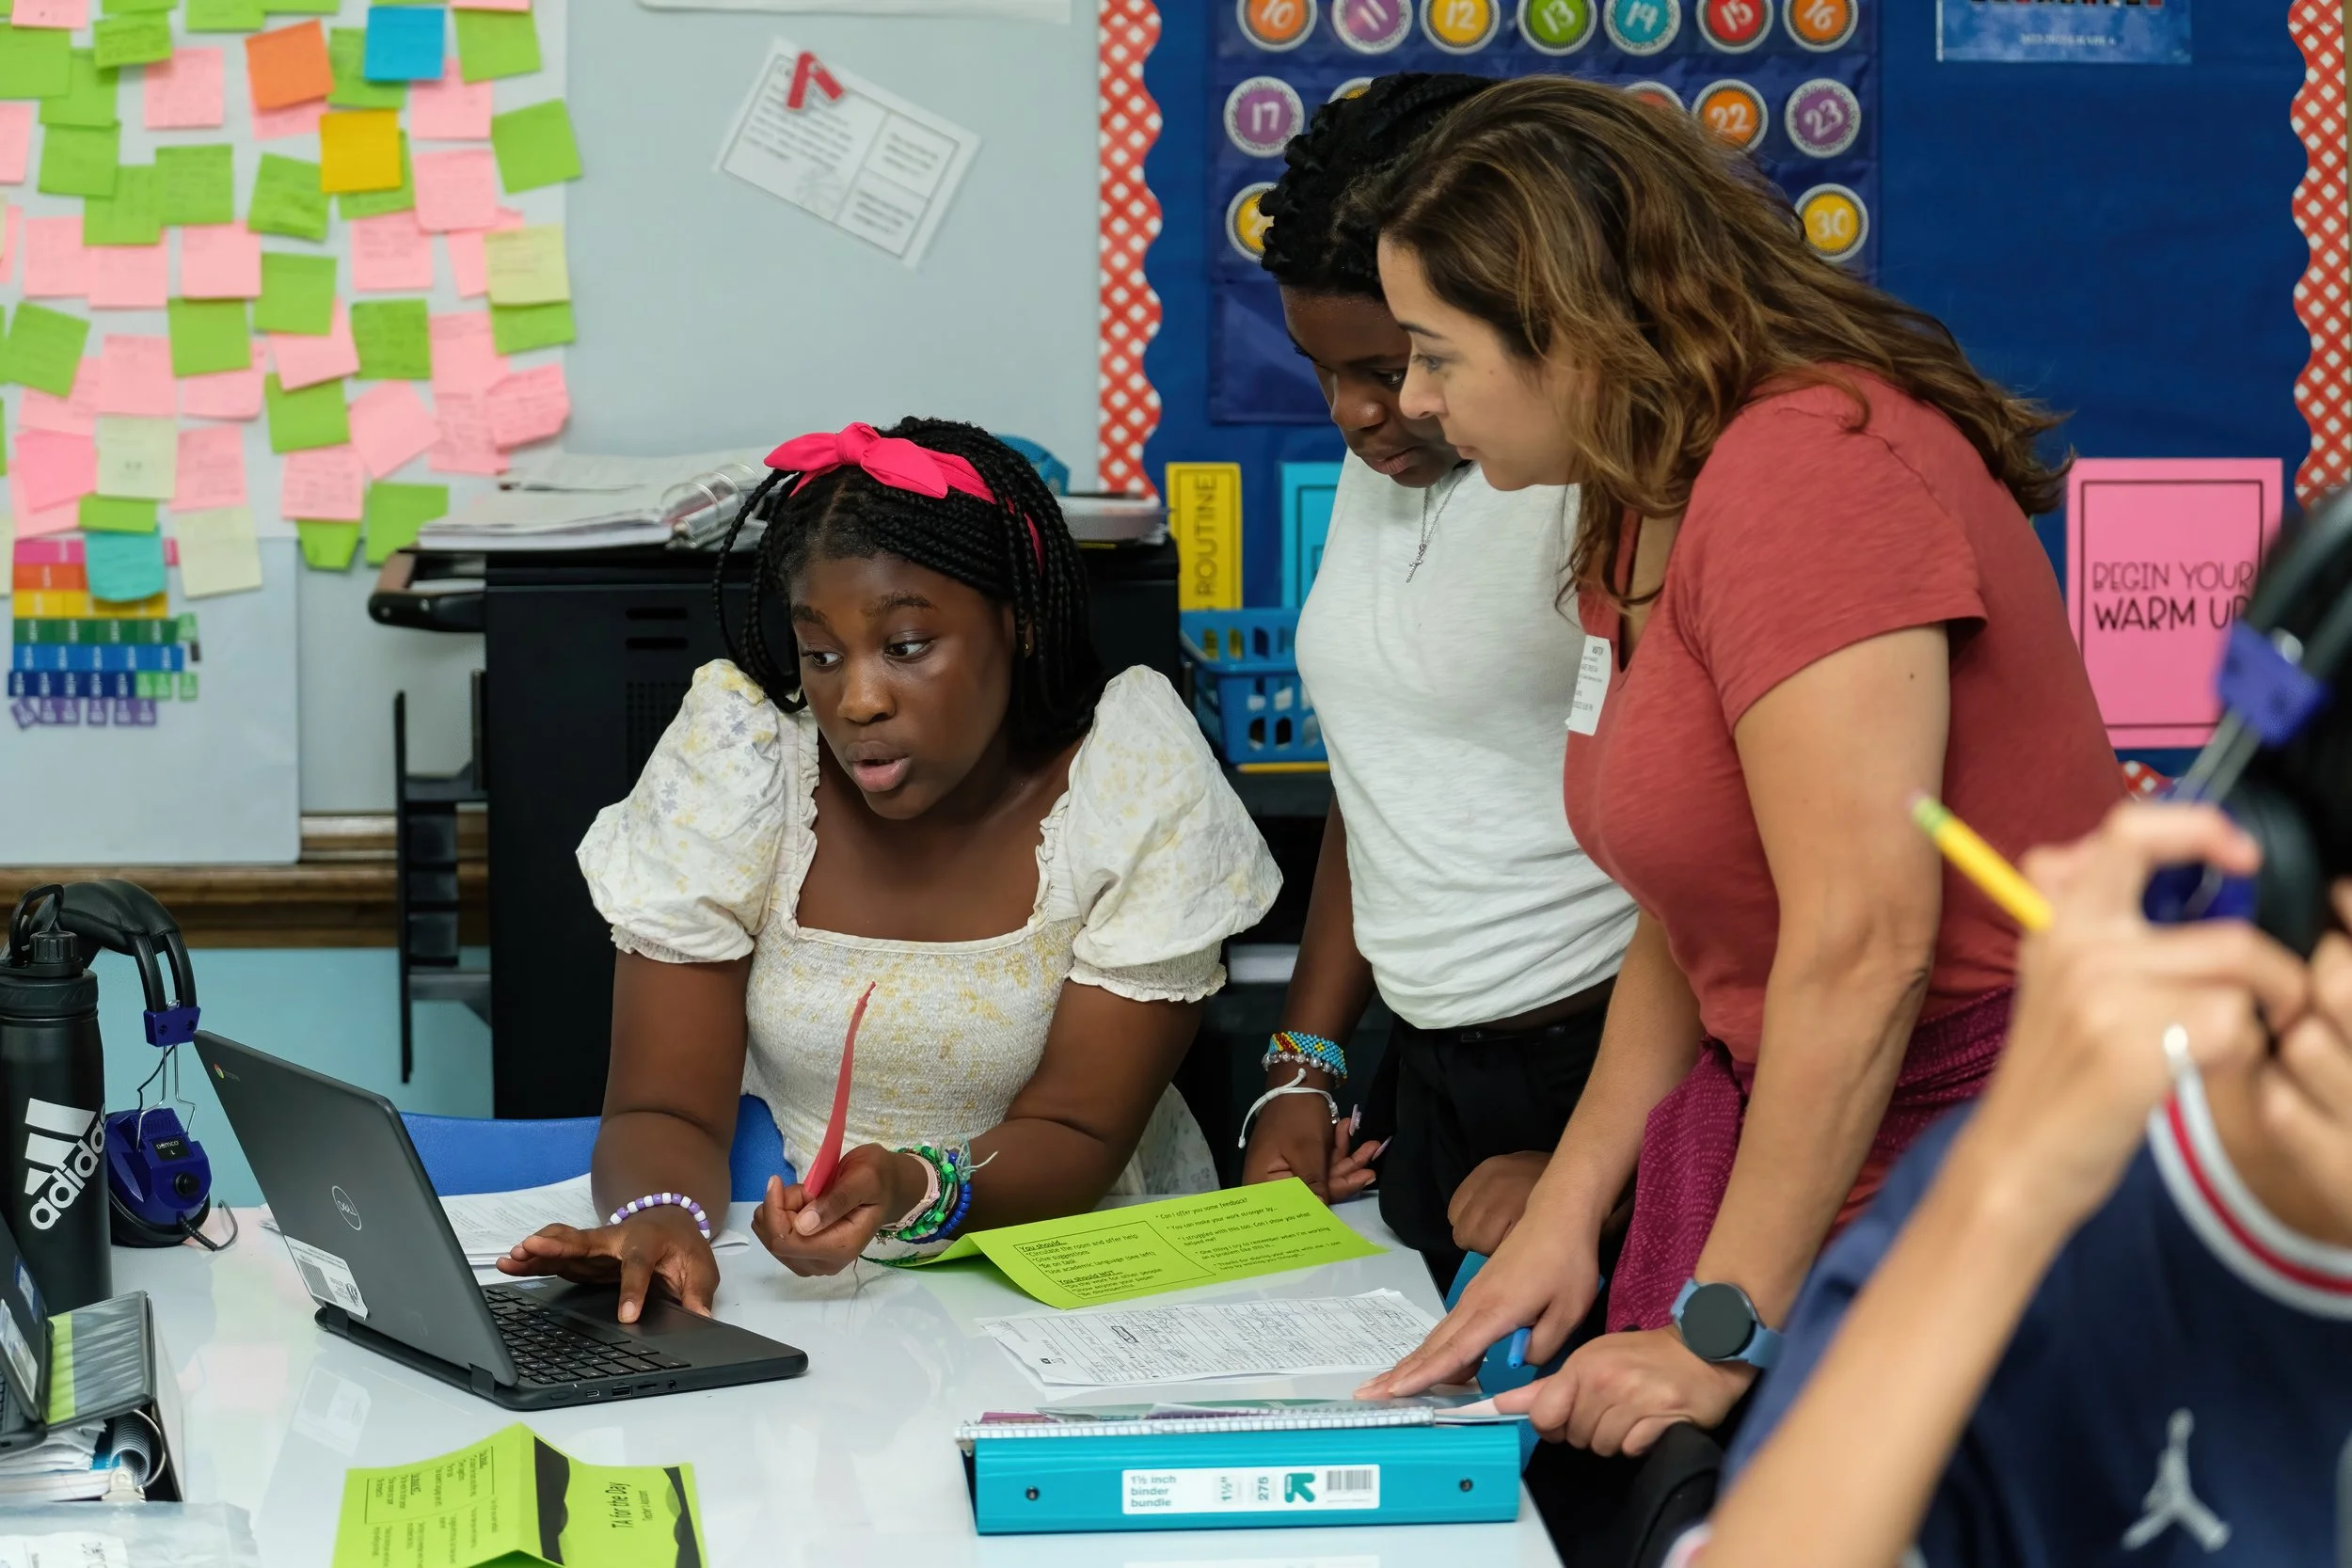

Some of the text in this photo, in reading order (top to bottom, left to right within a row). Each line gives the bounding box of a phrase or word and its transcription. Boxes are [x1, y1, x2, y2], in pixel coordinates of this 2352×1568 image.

[1260, 0, 1296, 29] 10
[1444, 0, 1477, 30] 12
[1539, 0, 1576, 34] 13
[1625, 1, 1660, 32] 14
[1719, 1, 1755, 32] 15
[1804, 0, 1838, 30] 16
[1251, 102, 1280, 134] 17
[1708, 103, 1751, 133] 22
[1804, 99, 1843, 138] 23
[1813, 206, 1850, 240] 30
[1193, 472, 1219, 597] ROUTINE
[2092, 560, 2254, 592] BEGIN YOUR
[2093, 596, 2196, 631] WARM
[30, 1102, 106, 1229] adida
[337, 1199, 358, 1216] DELL
[1218, 1197, 1248, 1209] feedback?
[1240, 1208, 1264, 1218] stronger
[1185, 1230, 1214, 1241] struggled
[1249, 1236, 1279, 1245] remember
[1052, 1248, 1089, 1260] suggestions
[1061, 1261, 1093, 1271] academic
[1093, 1258, 1124, 1266] language
[1073, 1273, 1099, 1282] should
[1131, 1487, 1168, 1496] binder
[1152, 1475, 1176, 1483] inch
[605, 1481, 633, 1528] TA for the Day
[1131, 1497, 1171, 1507] bundle
